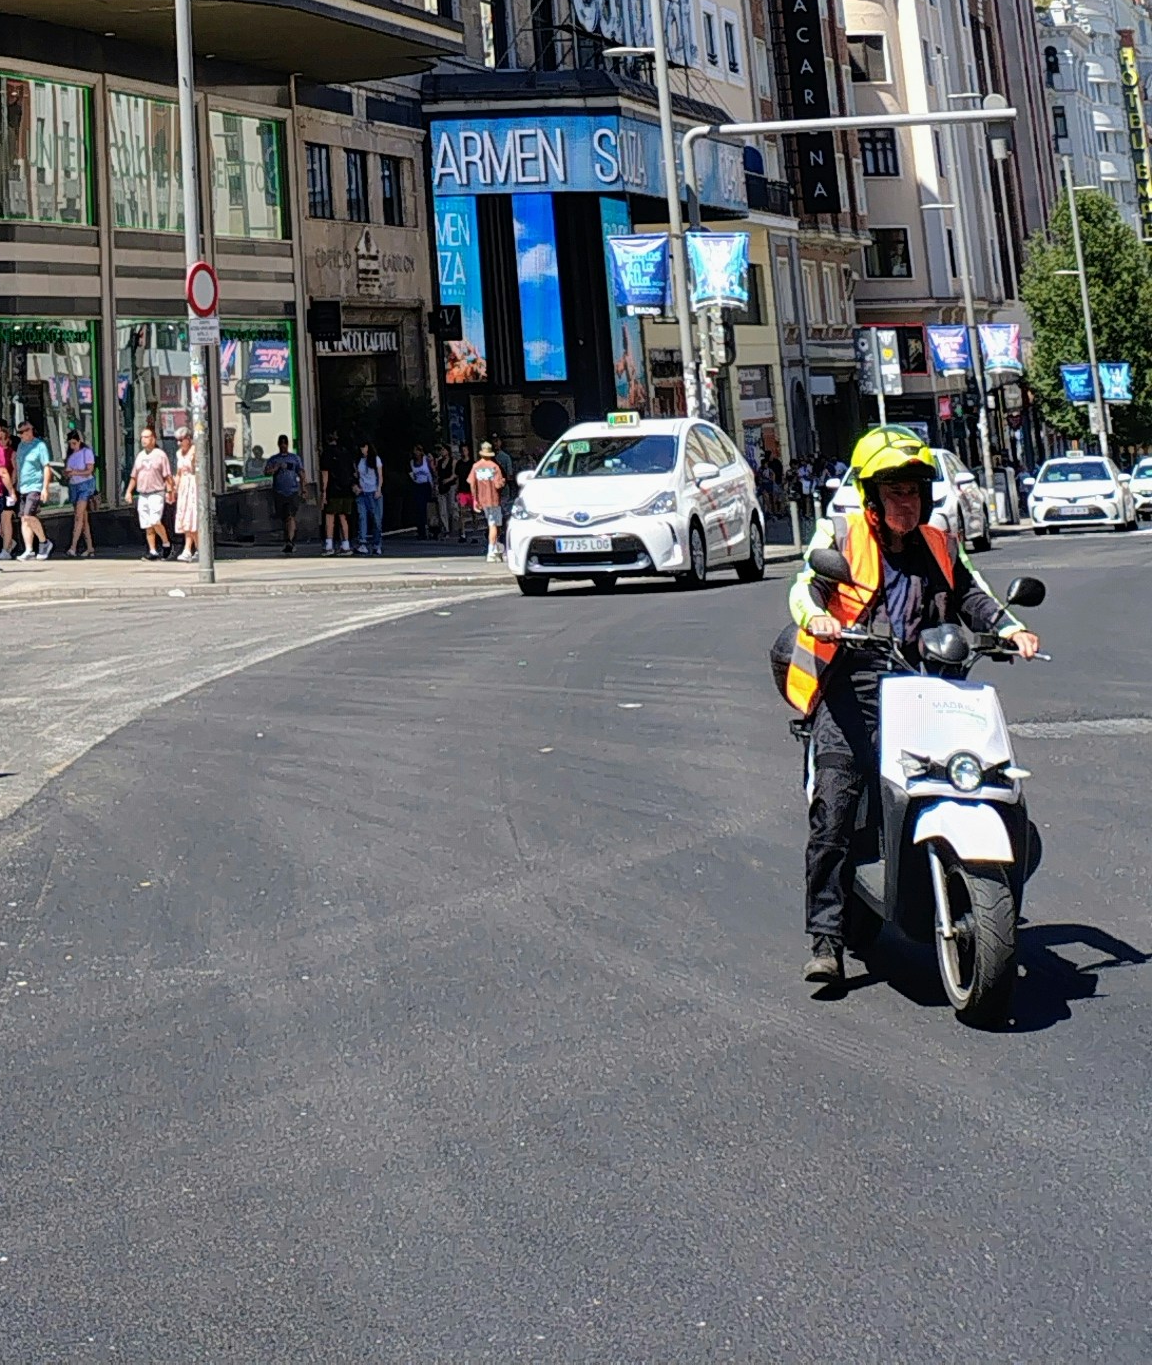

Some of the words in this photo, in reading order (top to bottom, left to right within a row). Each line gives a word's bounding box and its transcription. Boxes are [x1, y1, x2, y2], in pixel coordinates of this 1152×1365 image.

[1119, 46, 1147, 150] HOTEL
[432, 127, 566, 186] ARMEN
[563, 538, 588, 551] 7735
